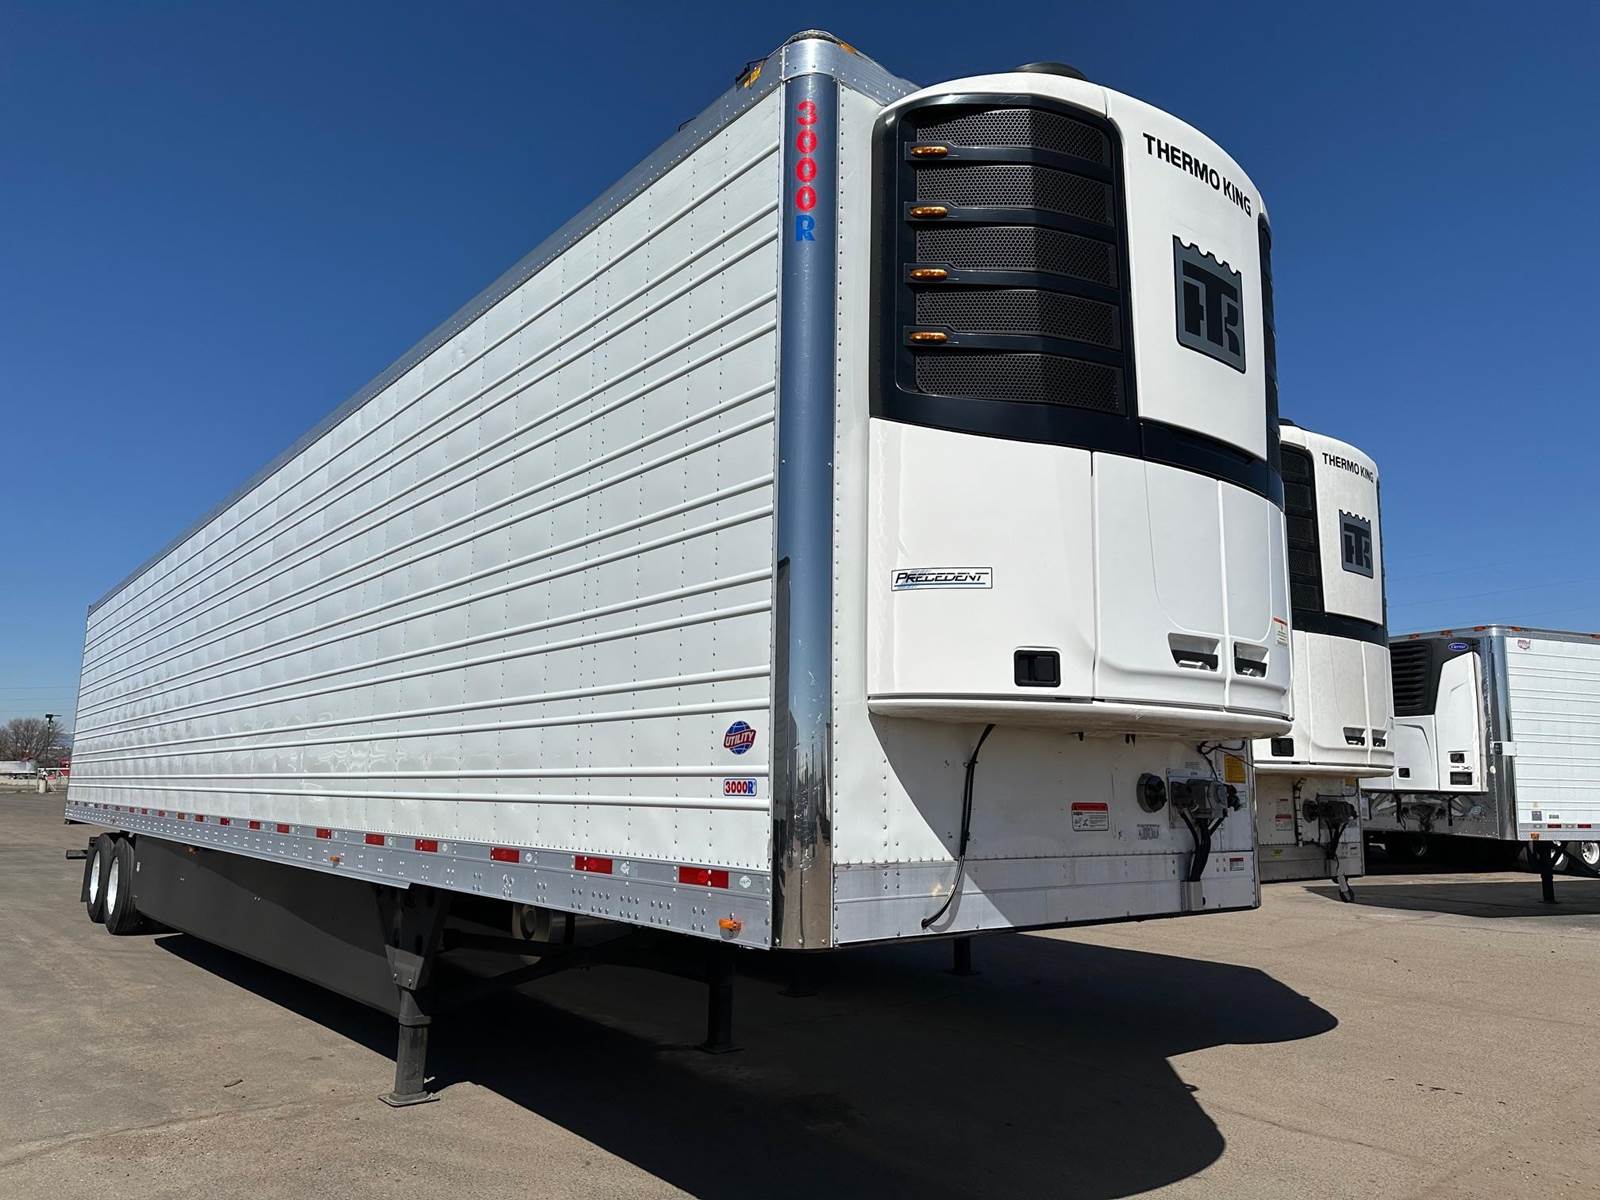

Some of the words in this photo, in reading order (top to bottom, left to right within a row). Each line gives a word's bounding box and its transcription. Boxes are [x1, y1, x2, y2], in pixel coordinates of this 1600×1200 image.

[796, 101, 818, 242] 3000R
[1142, 132, 1221, 191] THERMO
[1222, 176, 1252, 218] KING
[1321, 452, 1360, 475] THERMO
[895, 572, 990, 584] PRECEDENT
[725, 731, 755, 747] UTILITY
[725, 780, 754, 794] 3000R
